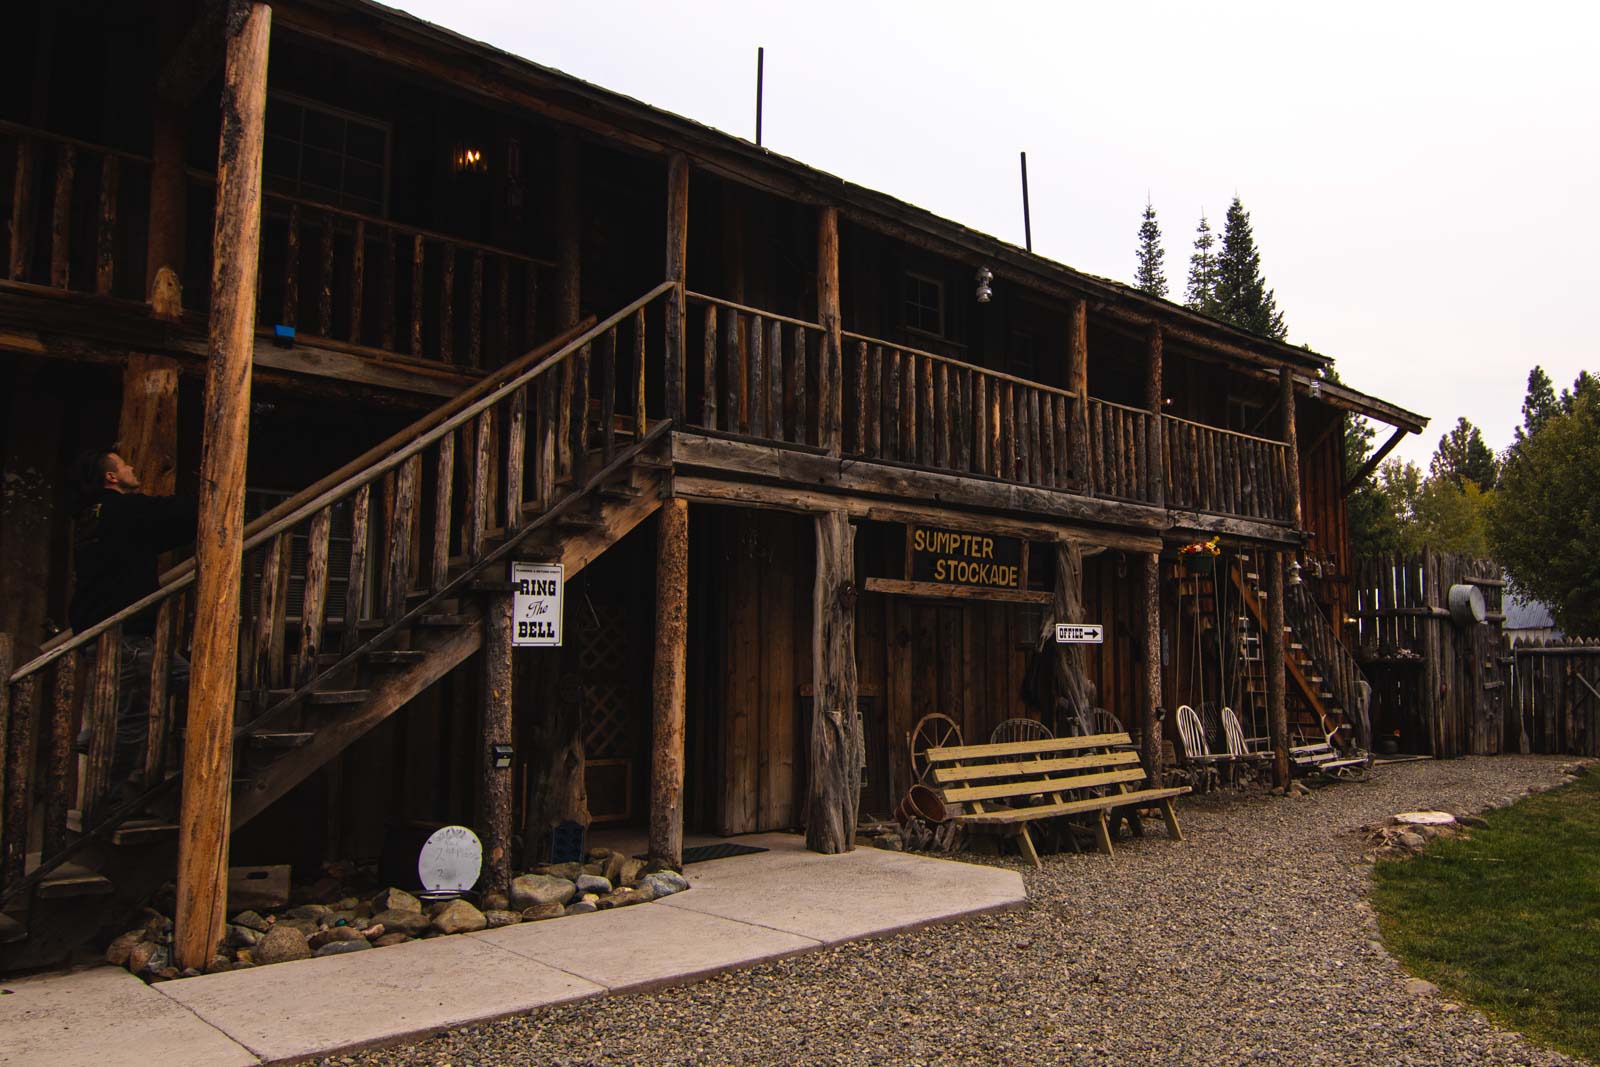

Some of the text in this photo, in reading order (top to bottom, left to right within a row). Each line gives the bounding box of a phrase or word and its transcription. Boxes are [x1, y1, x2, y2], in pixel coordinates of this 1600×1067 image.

[914, 528, 994, 559] SUMPTER
[934, 558, 1018, 587] STOCKADE
[519, 579, 557, 596] RING
[526, 599, 549, 618] The
[518, 621, 555, 638] BELL
[1059, 627, 1083, 639] OFFICE
